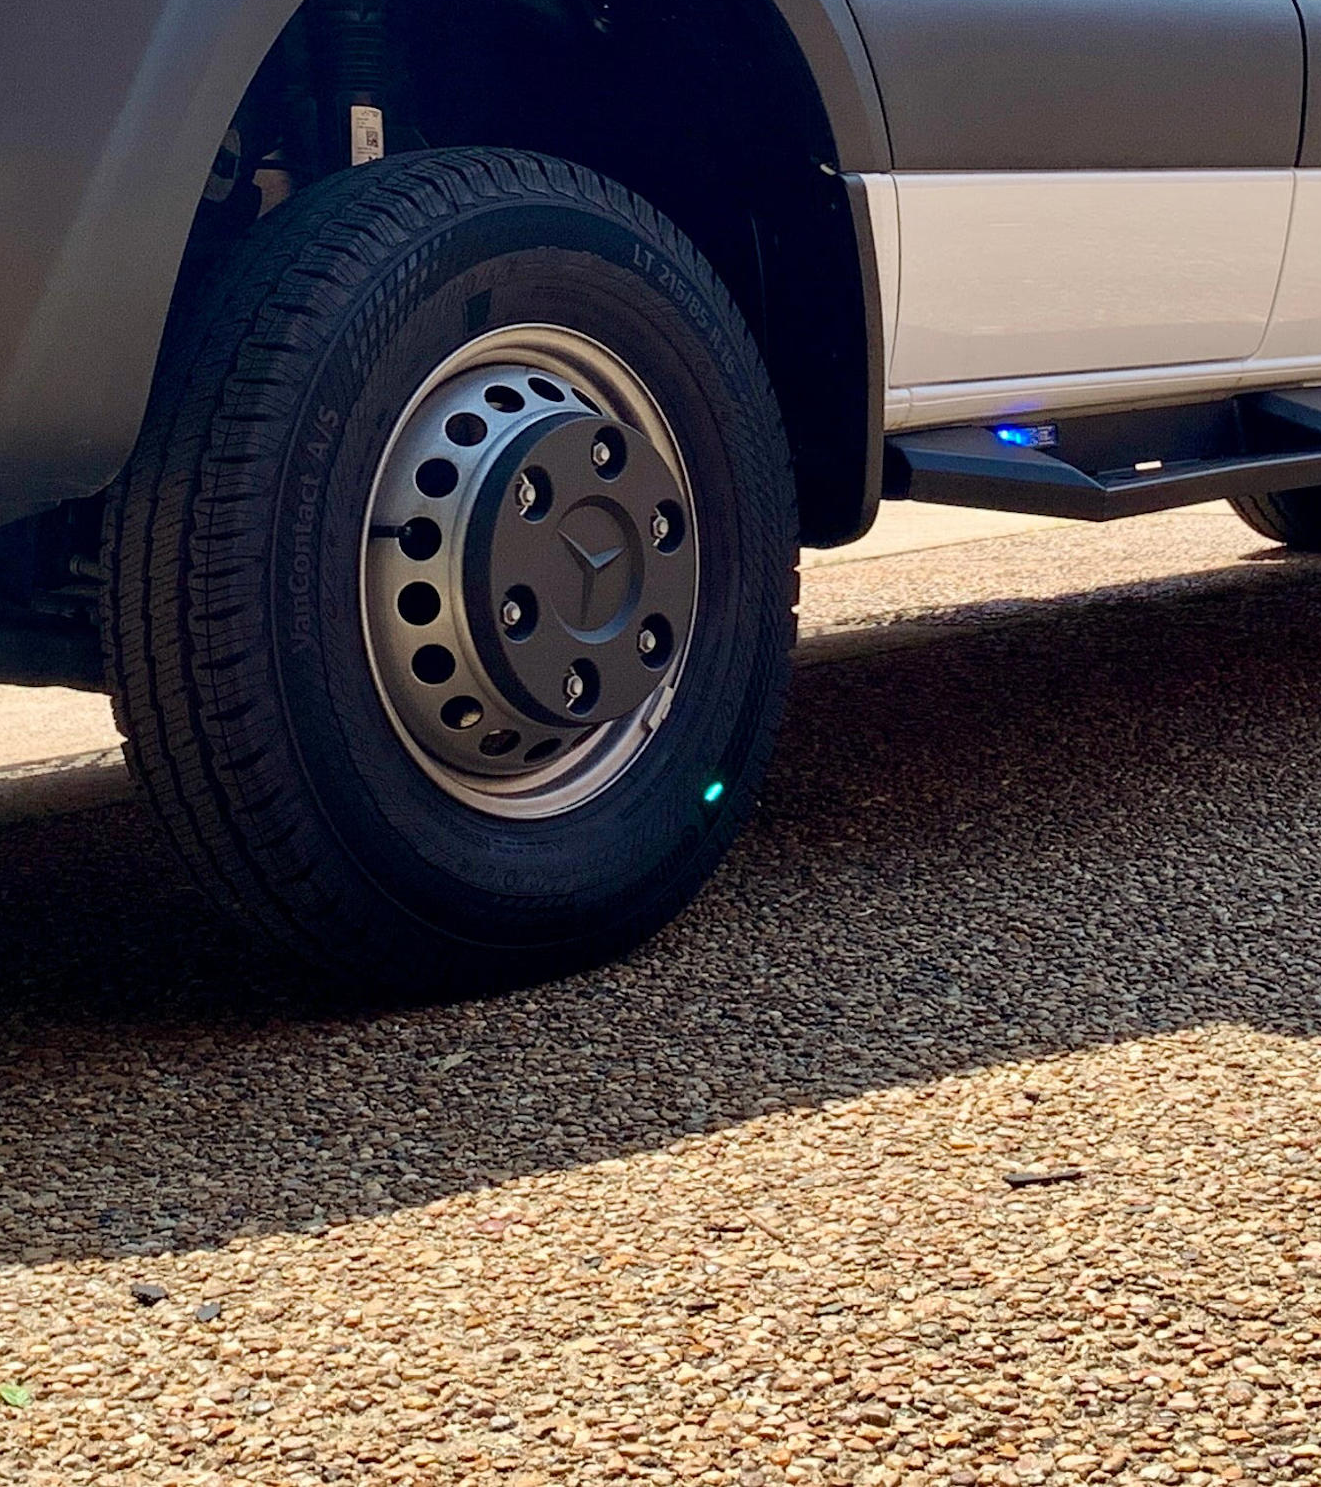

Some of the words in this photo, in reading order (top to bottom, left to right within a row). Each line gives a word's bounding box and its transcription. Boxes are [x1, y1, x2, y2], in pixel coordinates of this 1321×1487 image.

[633, 243, 655, 273] LT
[658, 263, 710, 329] 215/85
[289, 473, 320, 655] VanContact
[307, 403, 339, 459] A/S
